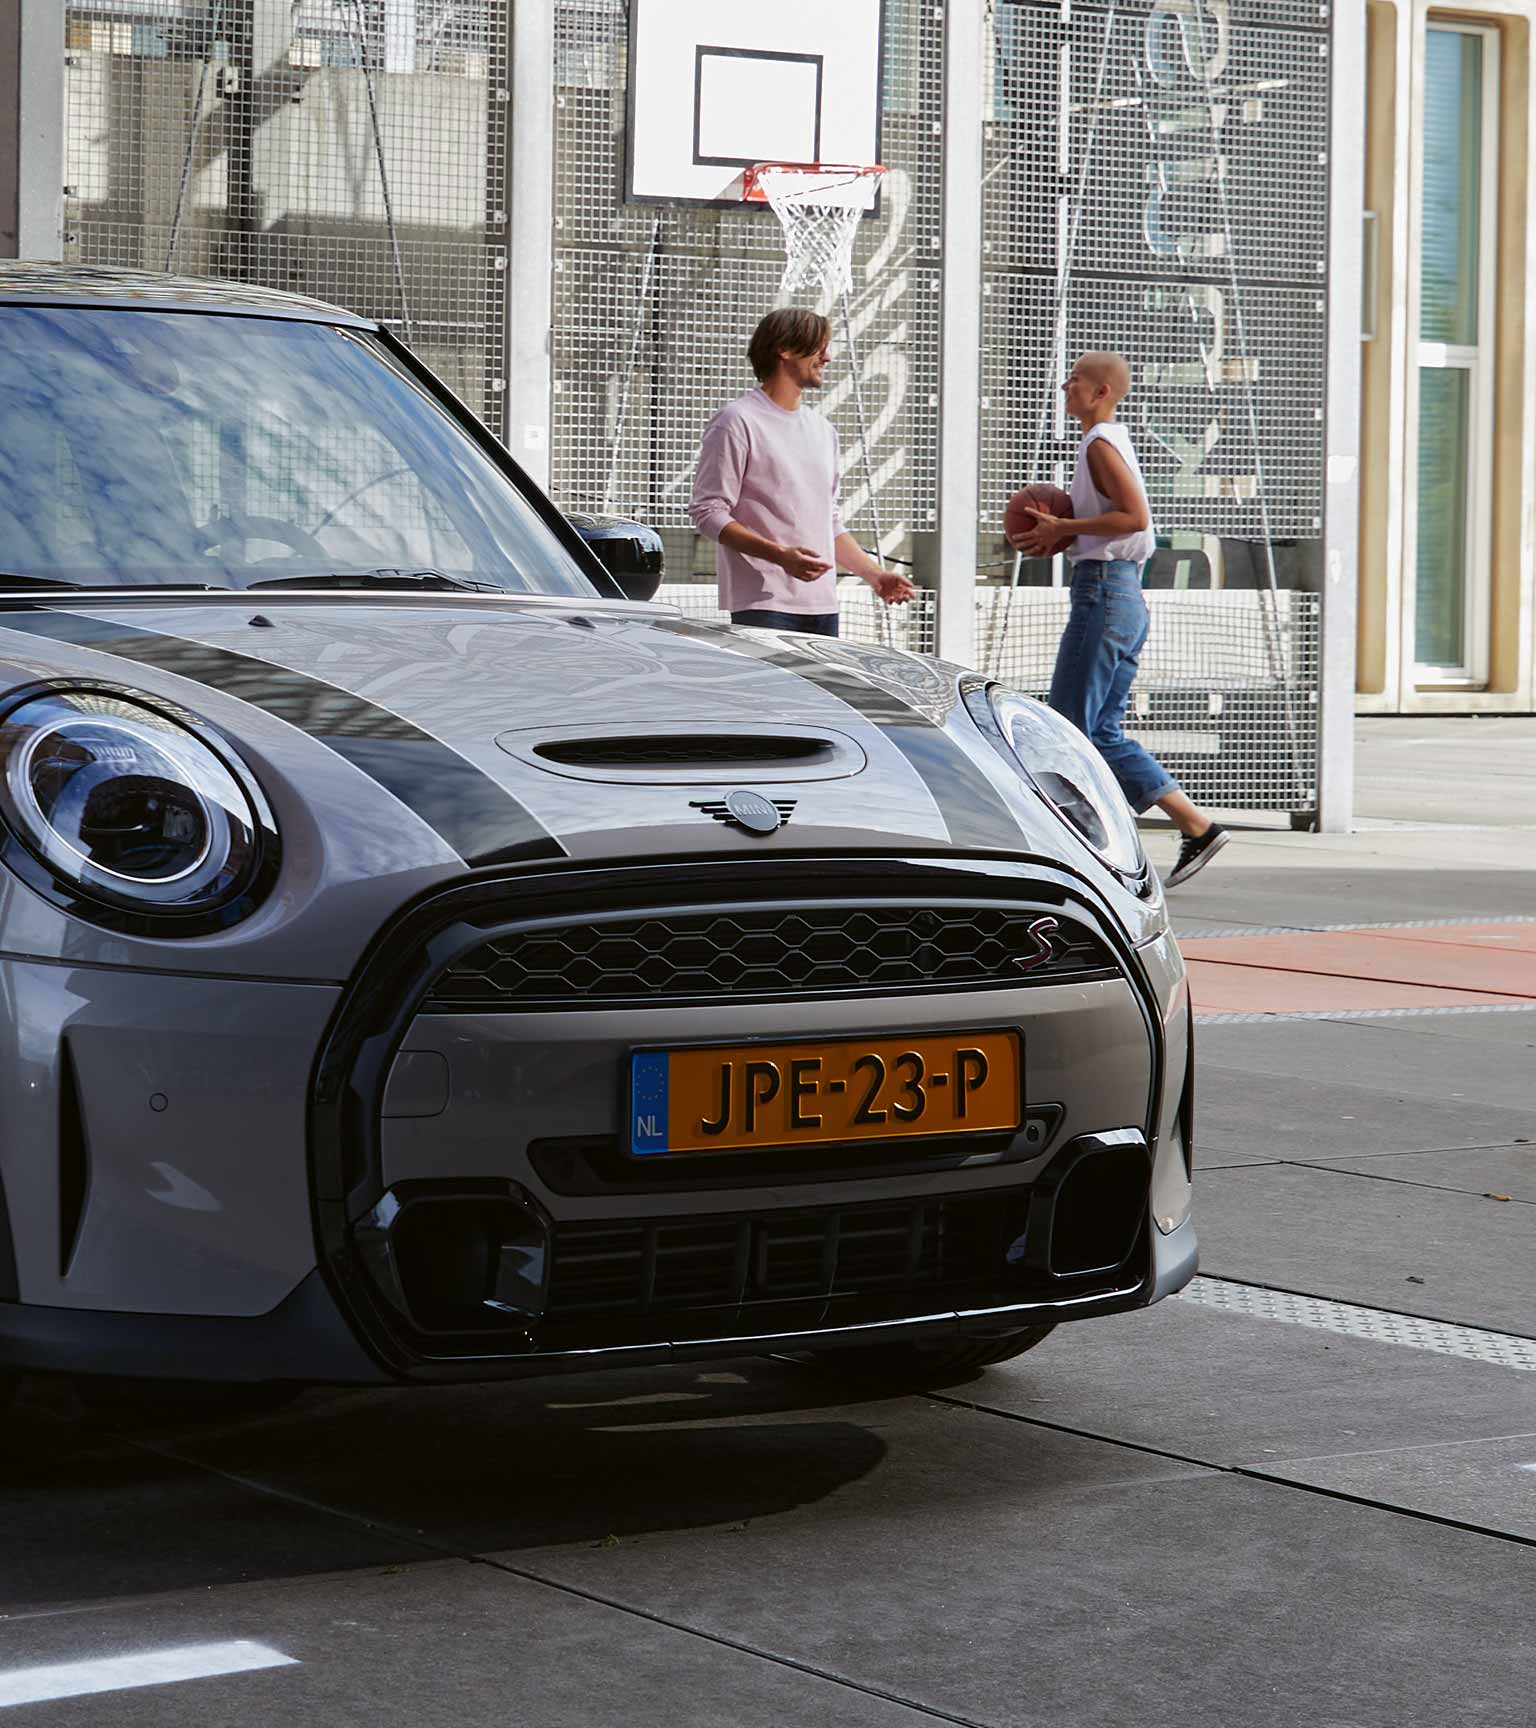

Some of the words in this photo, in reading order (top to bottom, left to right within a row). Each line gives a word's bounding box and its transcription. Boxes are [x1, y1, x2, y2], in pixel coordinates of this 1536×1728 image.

[734, 802, 772, 816] MINI
[1012, 916, 1059, 970] S
[702, 1048, 988, 1135] JPE-23-P
[637, 1115, 663, 1138] NL
